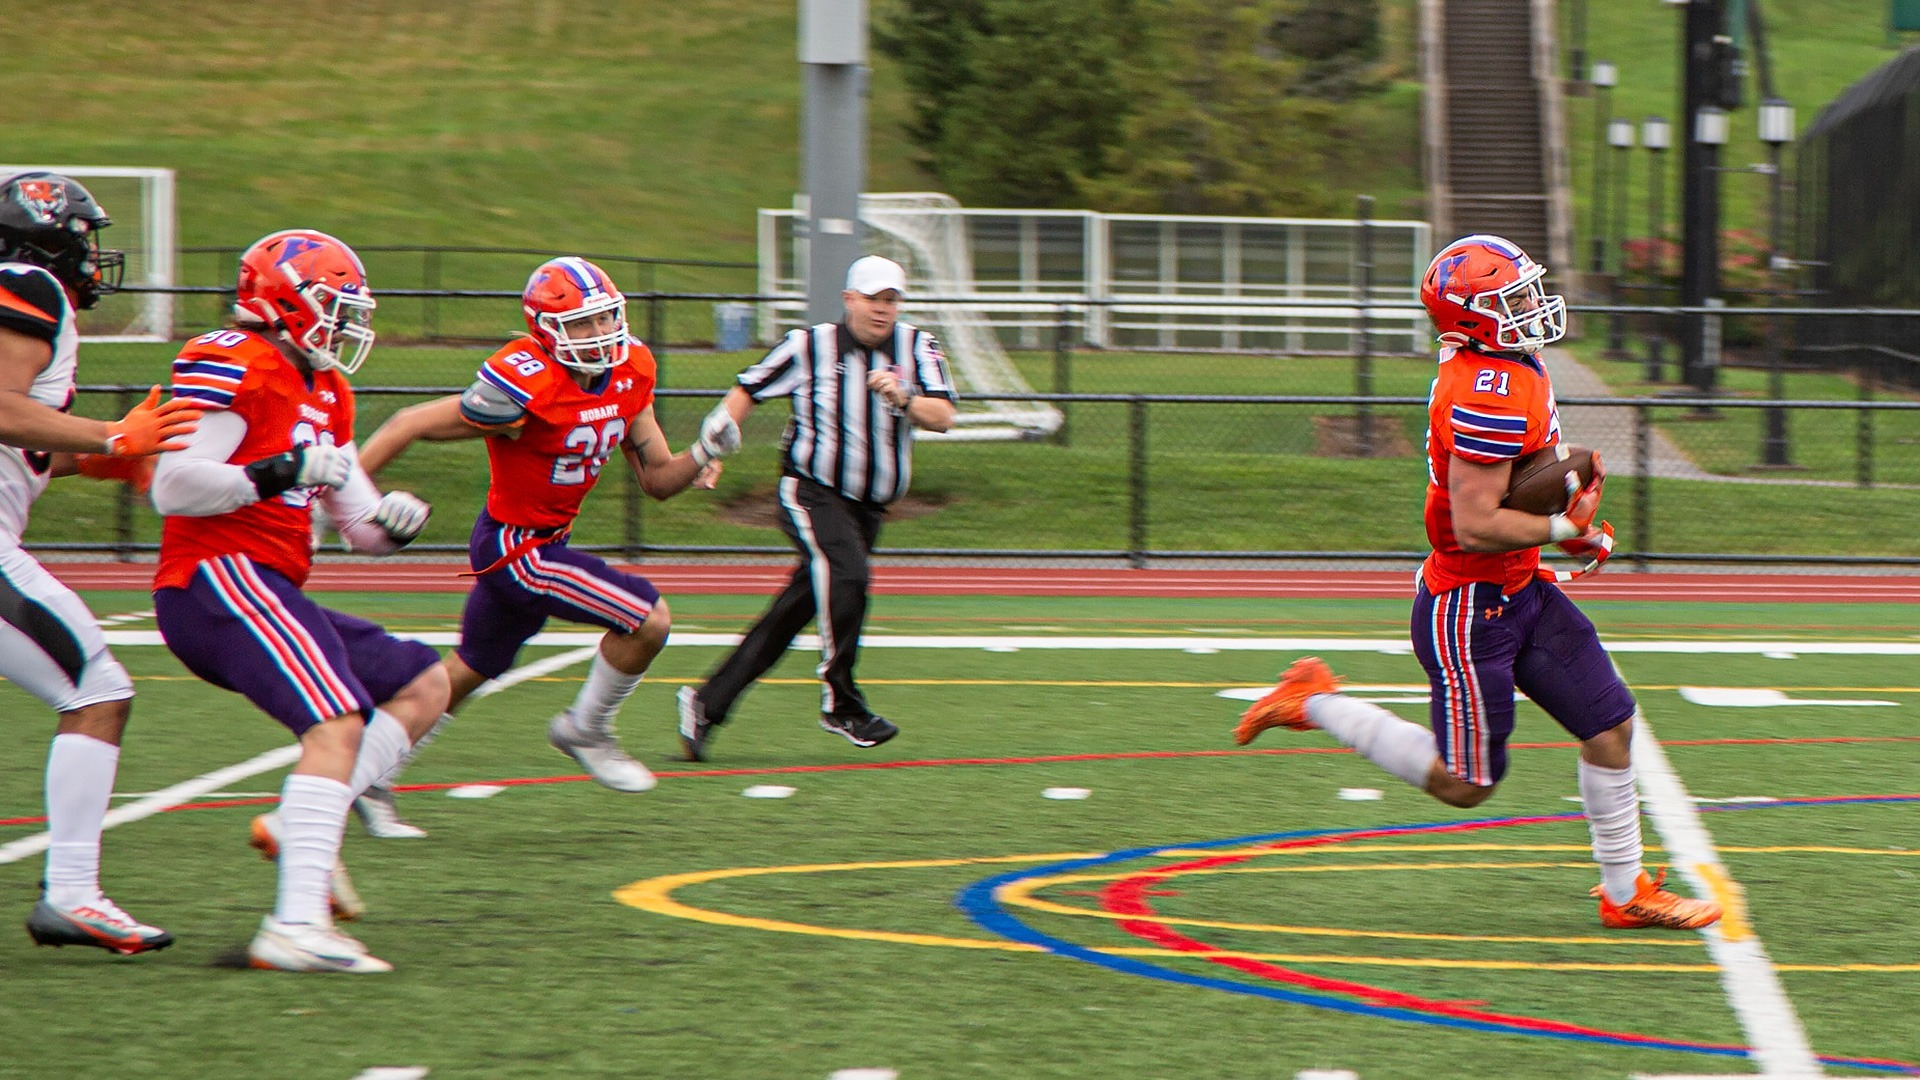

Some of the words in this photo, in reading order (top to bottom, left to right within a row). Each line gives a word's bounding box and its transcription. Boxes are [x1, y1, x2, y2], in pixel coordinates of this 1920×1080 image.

[197, 330, 248, 348] 90
[503, 350, 547, 377] 28
[1475, 368, 1511, 396] 21
[579, 403, 619, 423] HOBART
